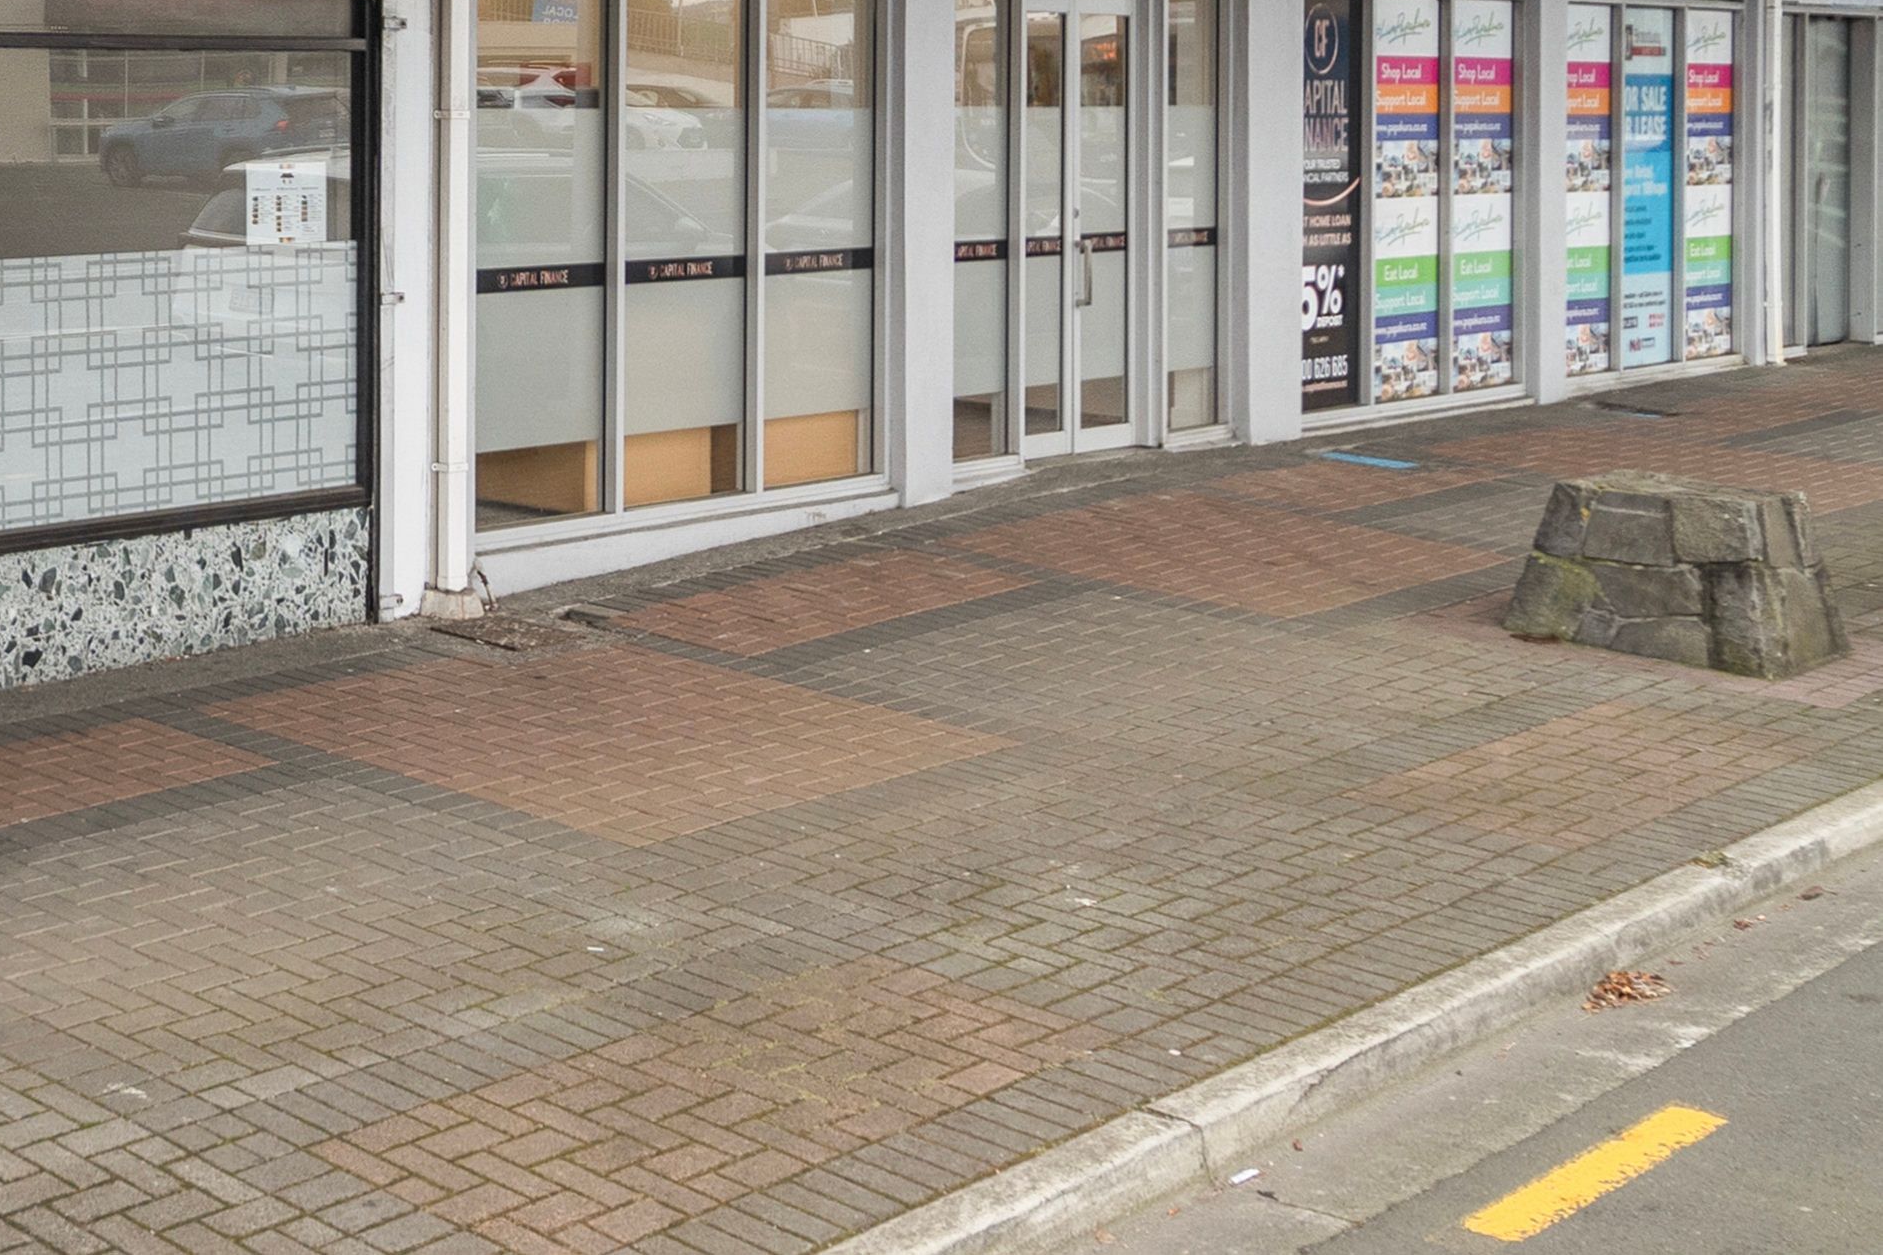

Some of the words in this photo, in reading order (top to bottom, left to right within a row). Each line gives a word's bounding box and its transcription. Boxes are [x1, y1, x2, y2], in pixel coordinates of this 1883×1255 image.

[1381, 63, 1401, 83] Shop
[1402, 63, 1422, 79] Local
[1458, 63, 1476, 84] Shop
[1477, 64, 1496, 79] Local
[1305, 79, 1348, 114] APITAL
[1407, 90, 1427, 106] Local
[1481, 90, 1500, 106] Local
[1625, 86, 1639, 112] OR
[1642, 86, 1667, 112] SALE
[1305, 117, 1349, 152] NANCE
[659, 263, 685, 278] CAPITAL
[686, 261, 714, 276] FINANCE
[794, 255, 818, 269] CAPITAL
[819, 253, 843, 267] FINANCE
[1474, 258, 1492, 274] Local
[510, 271, 538, 287] CAPITAL
[540, 269, 568, 285] FINANCE
[1399, 263, 1418, 279] Local
[1406, 290, 1426, 306] Local
[1314, 357, 1331, 379] 626
[1332, 355, 1349, 378] 685
